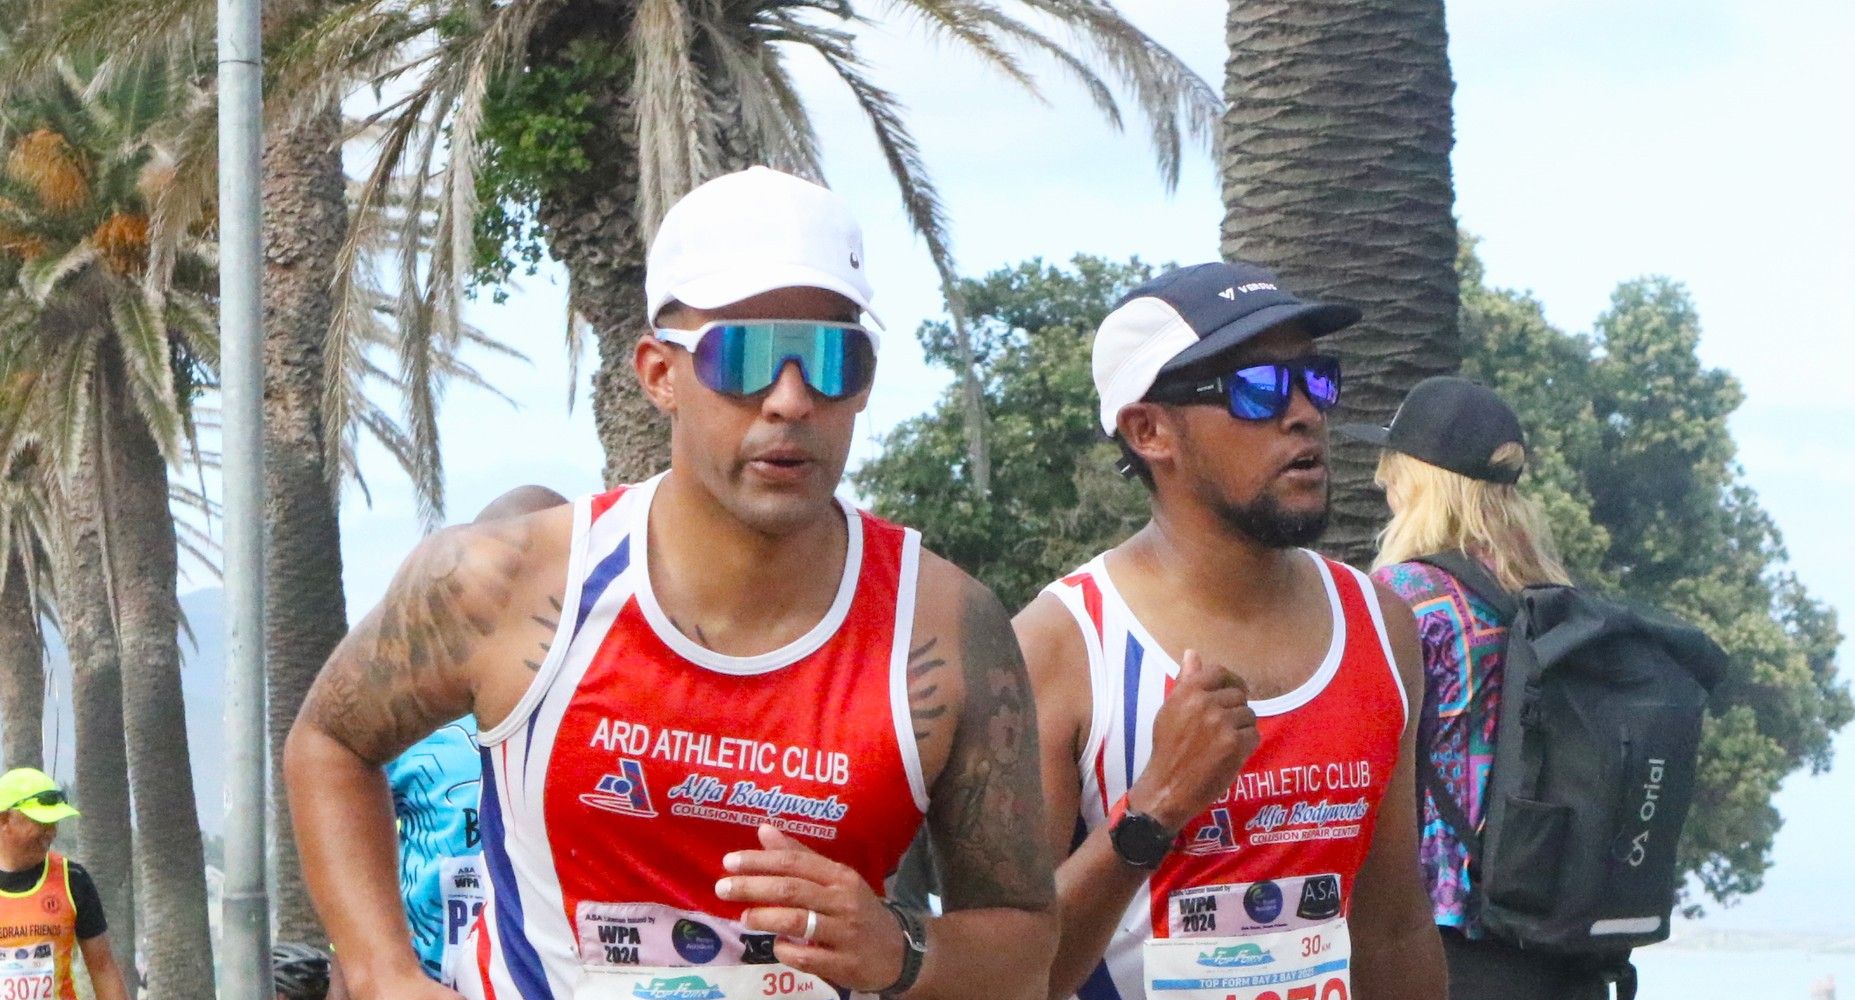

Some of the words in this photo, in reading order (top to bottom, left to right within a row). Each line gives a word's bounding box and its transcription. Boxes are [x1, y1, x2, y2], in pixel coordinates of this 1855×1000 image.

[590, 717, 650, 755] ARD
[651, 728, 776, 774] ATHLETIC
[782, 746, 849, 785] CLUB
[1234, 765, 1321, 802] ATHLETIC
[1326, 760, 1371, 788] CLUB
[668, 773, 727, 804] Alfa
[727, 781, 848, 820] Bodyworks
[673, 804, 738, 822] COLLISION
[741, 814, 785, 831] REPAIR
[788, 822, 835, 838] CENTRE
[1245, 803, 1288, 832] Alfa
[1288, 797, 1369, 827] Bodyworks
[1251, 830, 1299, 844] COLLISION
[1301, 828, 1330, 840] REPAIR
[455, 878, 479, 888] WPA
[1304, 879, 1338, 903] ASA
[1179, 895, 1217, 914] WPA
[1182, 914, 1216, 932] 2024
[598, 925, 641, 944] WPA
[605, 945, 640, 964] 2024
[1200, 979, 1219, 988] TOP
[1222, 977, 1250, 987] FORM
[1253, 976, 1271, 986] BAY
[1272, 975, 1278, 984] 2
[1280, 973, 1297, 982] BAY
